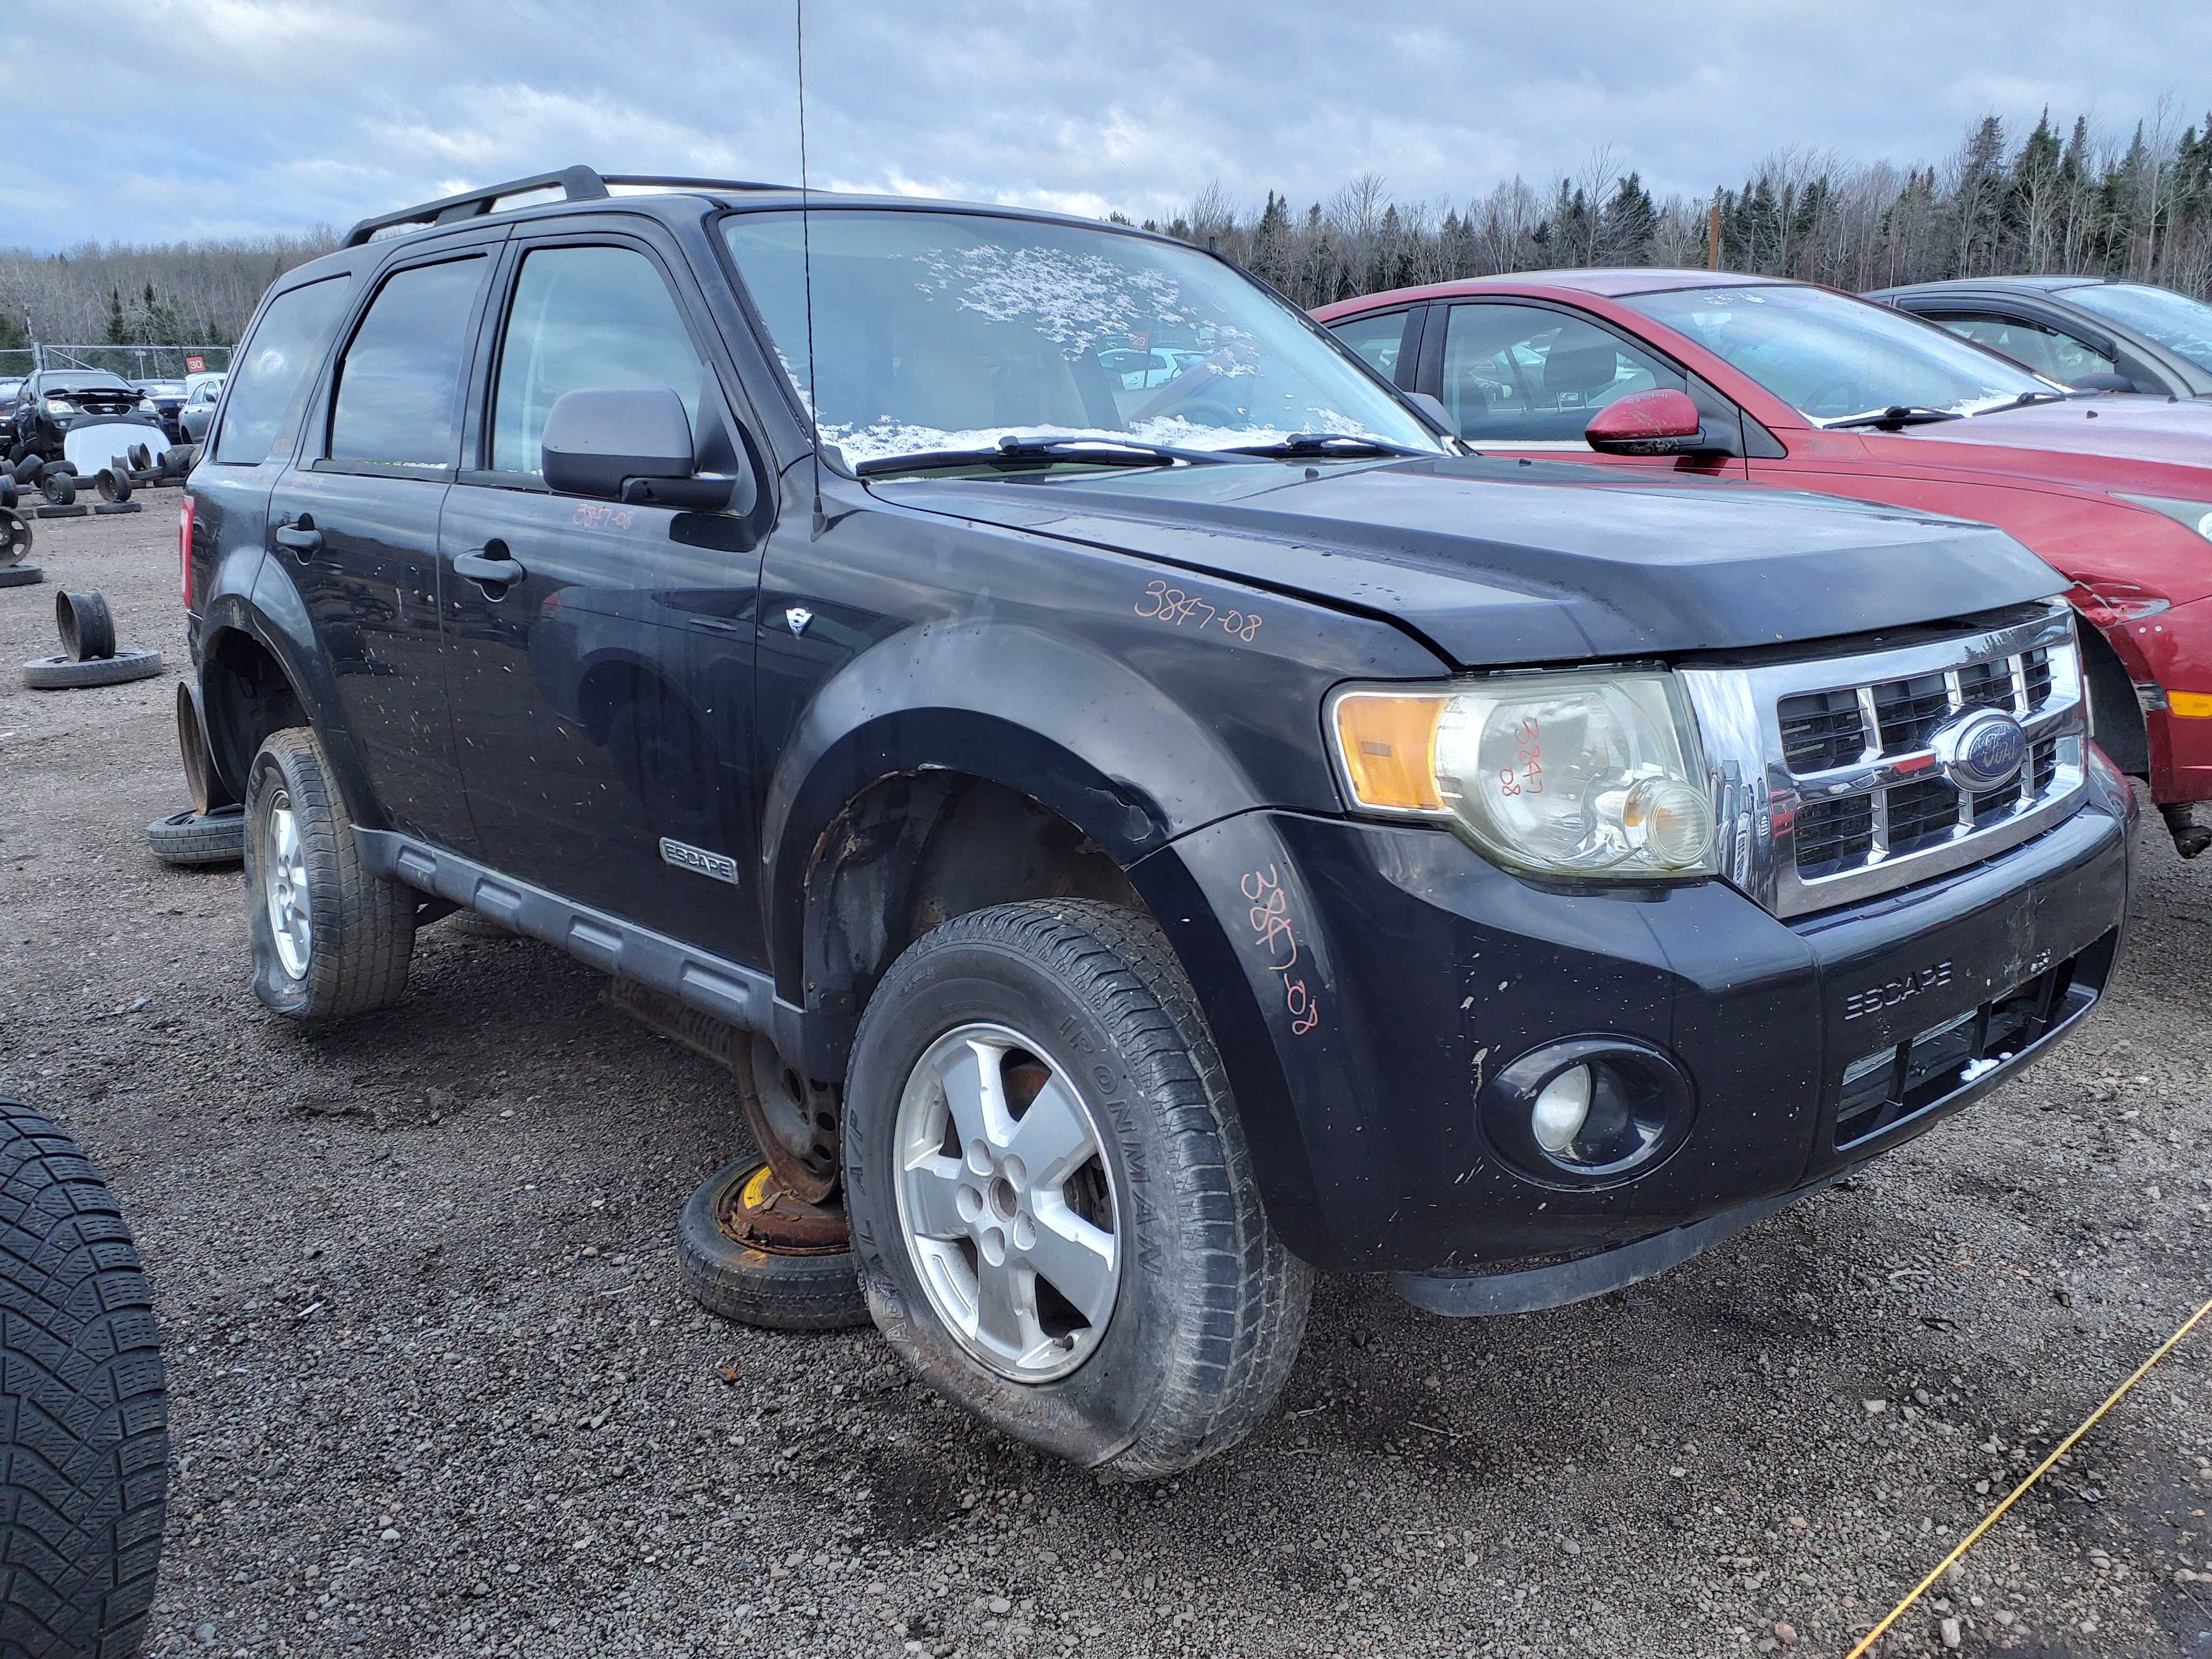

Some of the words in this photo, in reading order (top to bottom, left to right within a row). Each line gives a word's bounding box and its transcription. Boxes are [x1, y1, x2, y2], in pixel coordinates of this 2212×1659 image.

[189, 360, 202, 369] 30
[1132, 335, 1145, 346] 29
[1134, 580, 1263, 642] 3847-08
[1514, 718, 1543, 794] 3847
[1981, 726, 2016, 768] Ford
[1500, 767, 1521, 797] 08
[664, 843, 734, 878] ESCAPE
[1240, 863, 1318, 1035] 3847-08
[1844, 959, 1953, 1020] ESCAPE
[1059, 1016, 1163, 1276] IRONMAN
